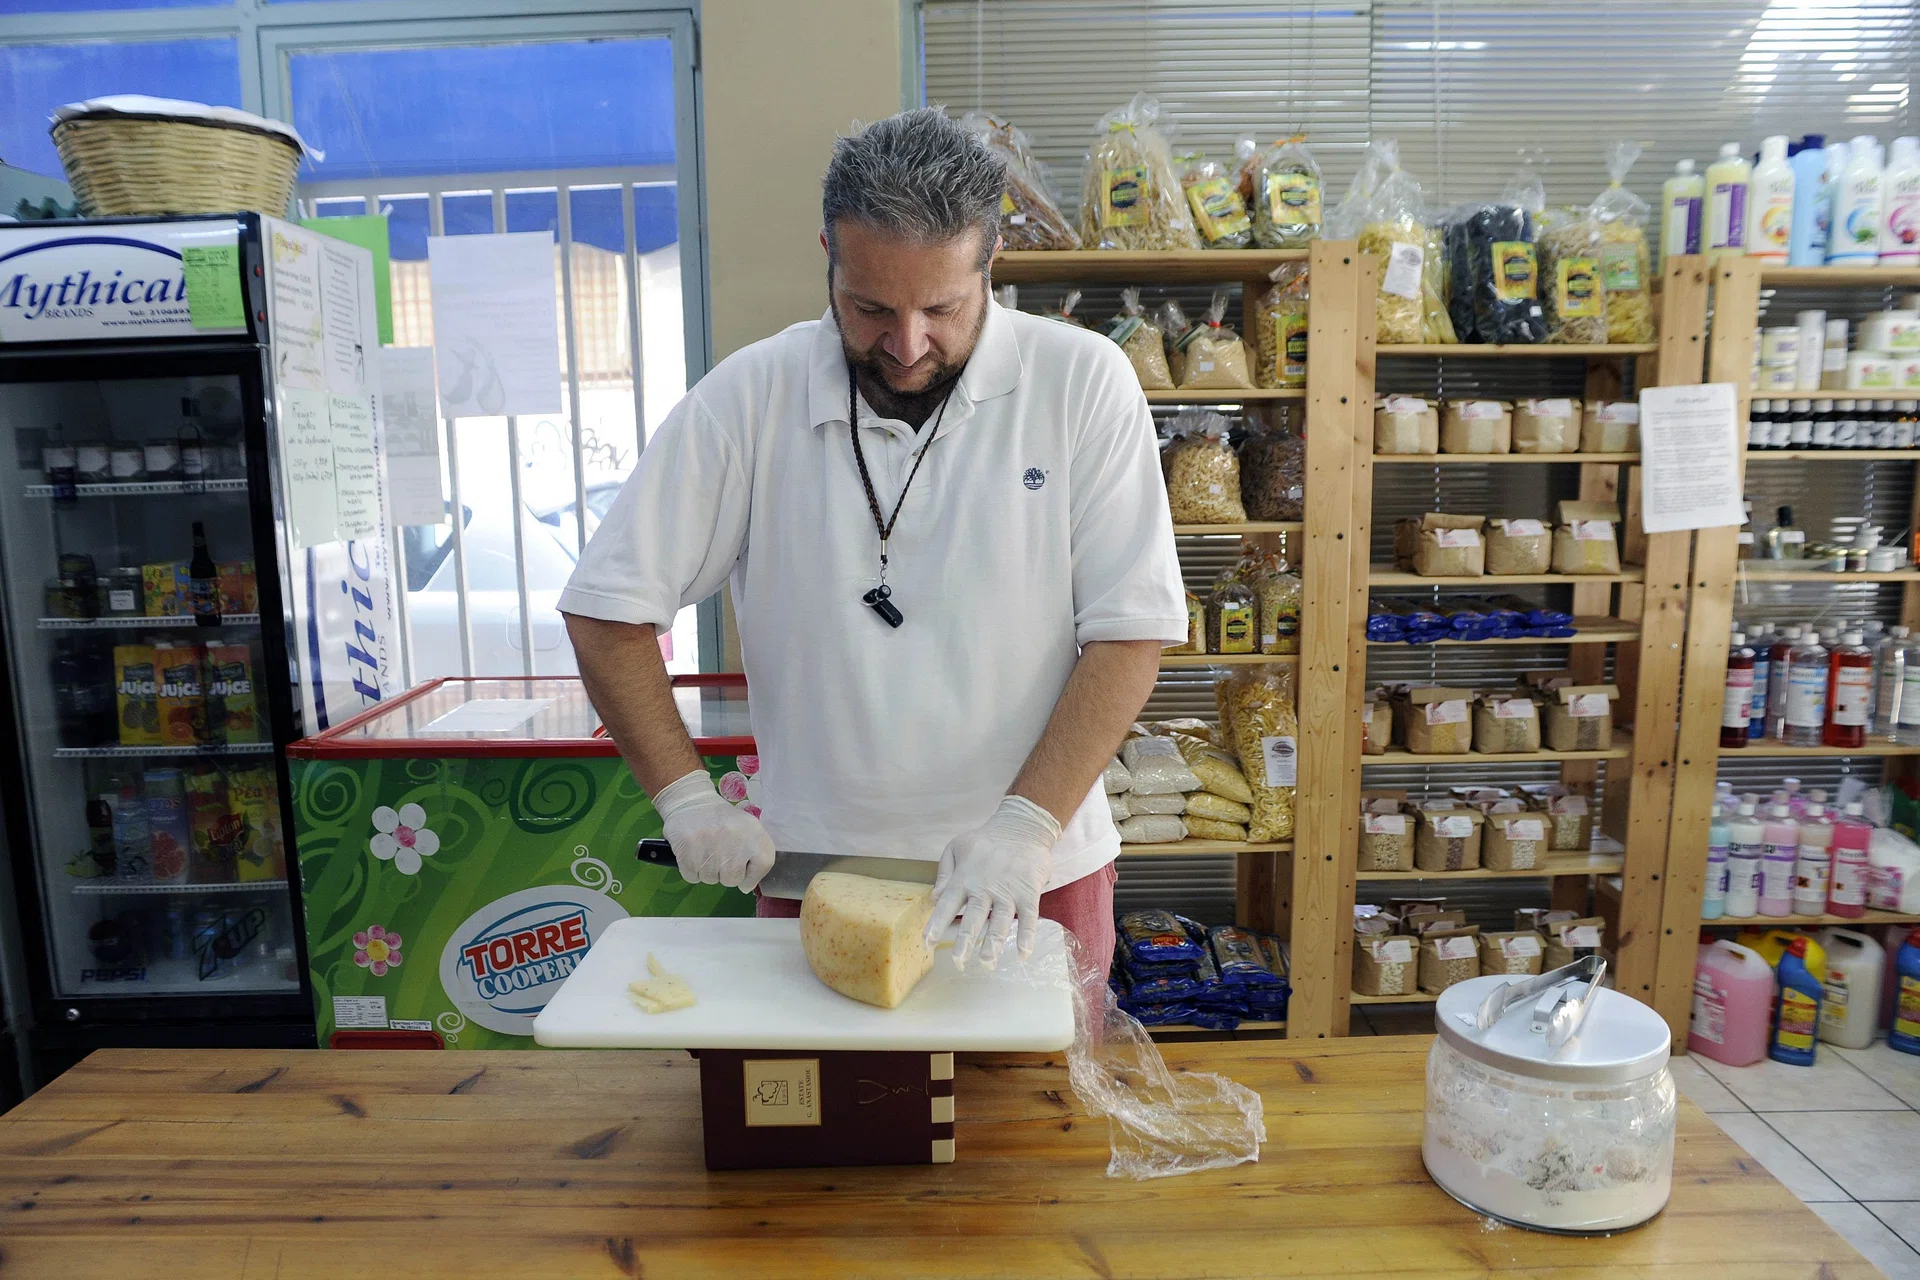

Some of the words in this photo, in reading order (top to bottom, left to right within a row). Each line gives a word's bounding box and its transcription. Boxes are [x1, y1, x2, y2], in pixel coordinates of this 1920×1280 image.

[45, 307, 95, 319] BRANDS
[208, 818, 243, 842] Lipton
[464, 916, 586, 977] TORRE
[80, 967, 146, 982] PEPSI
